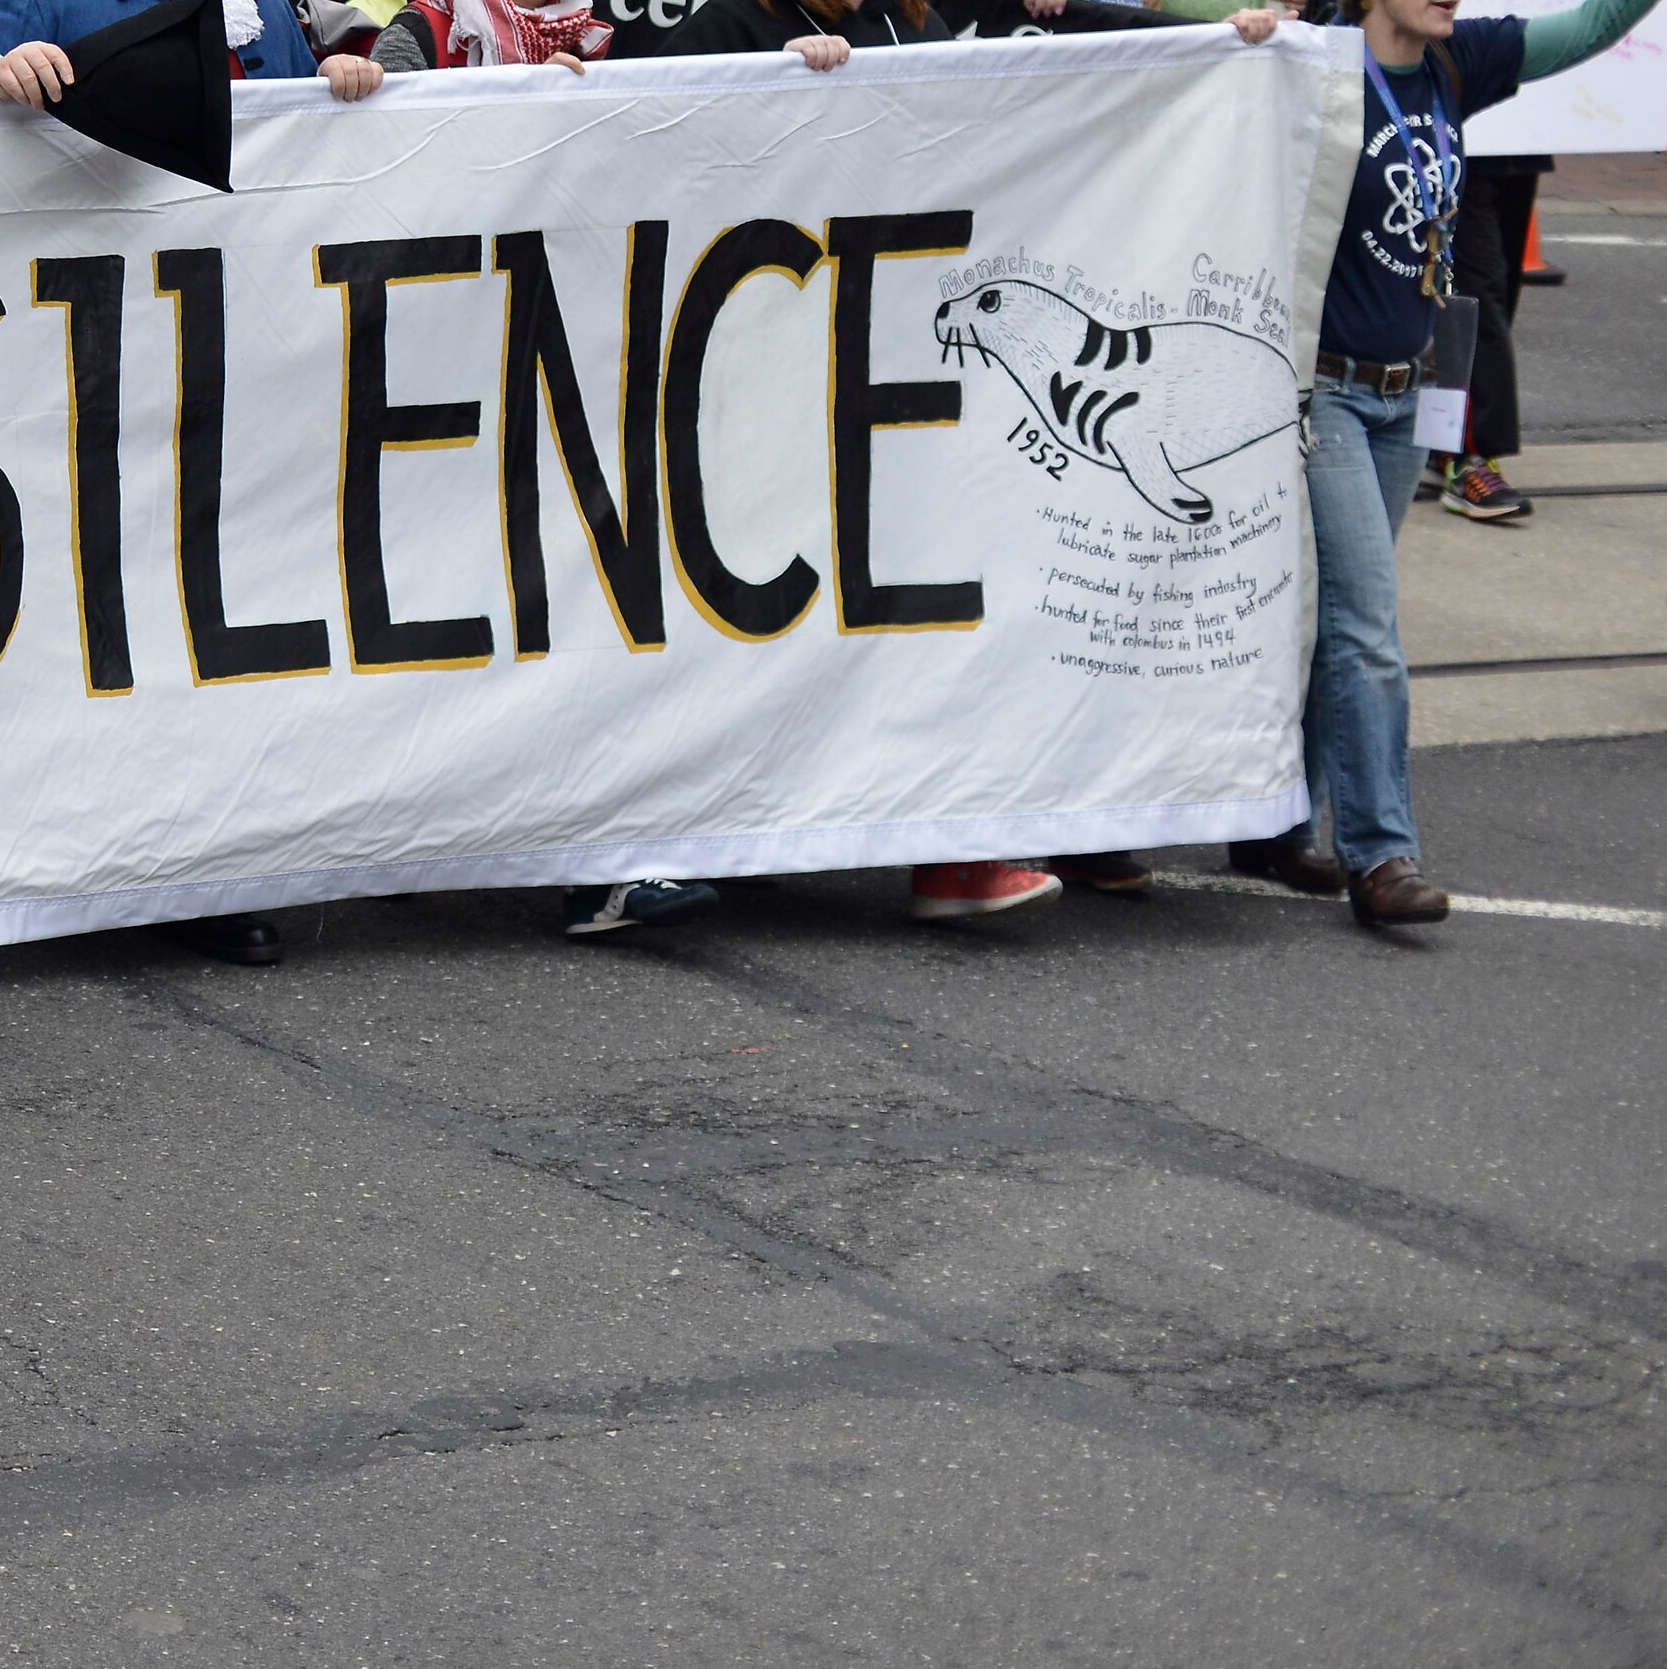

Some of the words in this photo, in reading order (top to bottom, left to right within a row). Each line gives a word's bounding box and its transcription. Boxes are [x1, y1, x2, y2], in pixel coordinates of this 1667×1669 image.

[939, 246, 1055, 299] Monachus
[1065, 265, 1166, 322] Tropicalis
[1186, 288, 1244, 325] Monk
[1006, 416, 1071, 483] 1952
[1042, 505, 1092, 531] Hunted
[1101, 521, 1114, 537] in
[1123, 523, 1144, 543] the
[1153, 526, 1180, 545] late
[1227, 509, 1248, 530] for
[1251, 493, 1270, 519] oil
[1056, 528, 1117, 562] lubricate
[1127, 551, 1164, 571] sugar
[1170, 544, 1228, 570] plantation
[1229, 514, 1283, 550] machinery
[1047, 566, 1121, 599] persecuted
[1127, 584, 1145, 606] by
[1153, 582, 1195, 610] fishing
[1203, 571, 1258, 600] industry
[1041, 593, 1087, 625] hunted
[1093, 611, 1111, 630] for
[1114, 613, 1139, 633] food
[1149, 615, 1186, 634] since
[1194, 612, 1229, 632] their
[1235, 598, 1257, 622] first
[1089, 628, 1116, 647] with
[1122, 632, 1175, 651] colombus
[1178, 634, 1191, 651] in
[1197, 627, 1237, 650] 1494
[1059, 651, 1147, 679] unaggressive,
[1154, 662, 1205, 677] curious
[1211, 647, 1264, 671] nature
